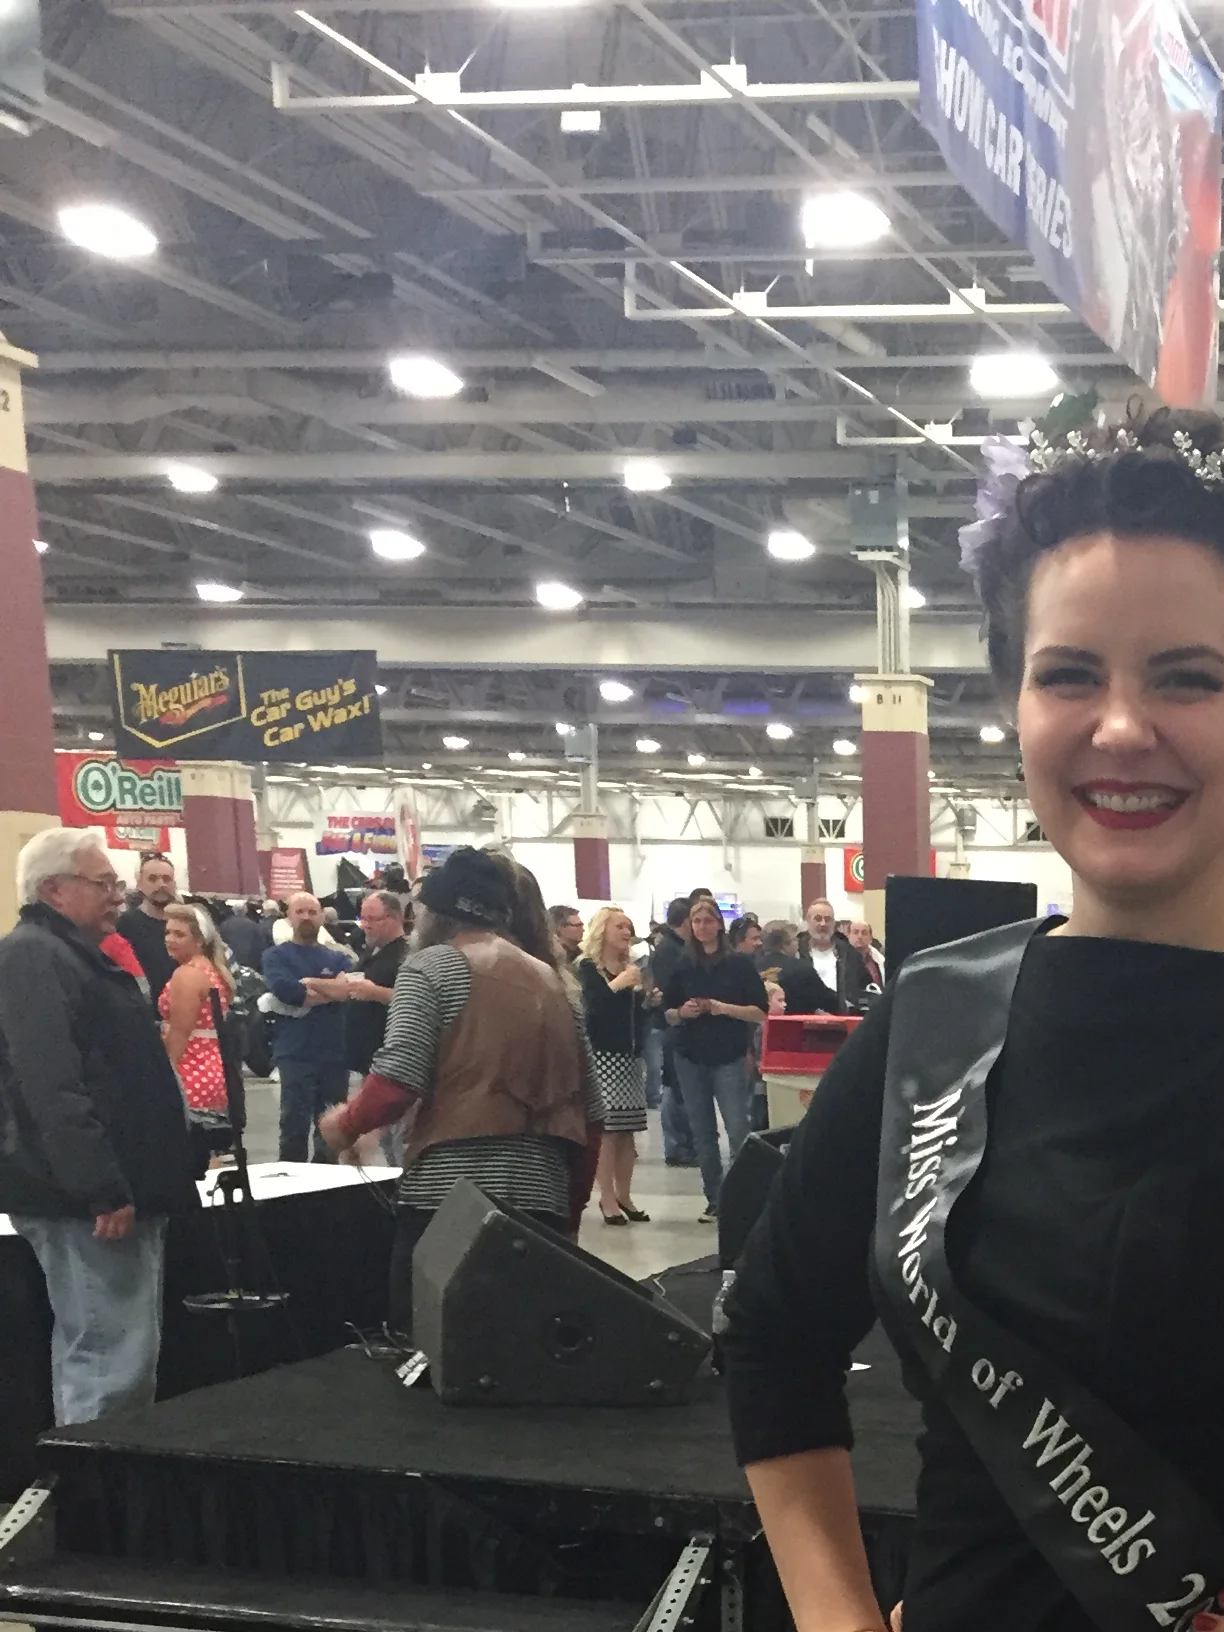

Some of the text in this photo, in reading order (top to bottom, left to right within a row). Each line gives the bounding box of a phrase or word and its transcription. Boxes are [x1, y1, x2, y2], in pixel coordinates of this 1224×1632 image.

[984, 98, 1024, 196] CAR
[131, 665, 230, 725] Meguiar's
[250, 678, 357, 727] Car Guy's
[260, 687, 290, 704] The
[263, 693, 374, 747] Car Wax!
[80, 764, 182, 808] O'Reill
[905, 1088, 962, 1200] Miss
[971, 1358, 1024, 1409] of
[1022, 1397, 1157, 1576] Wheels
